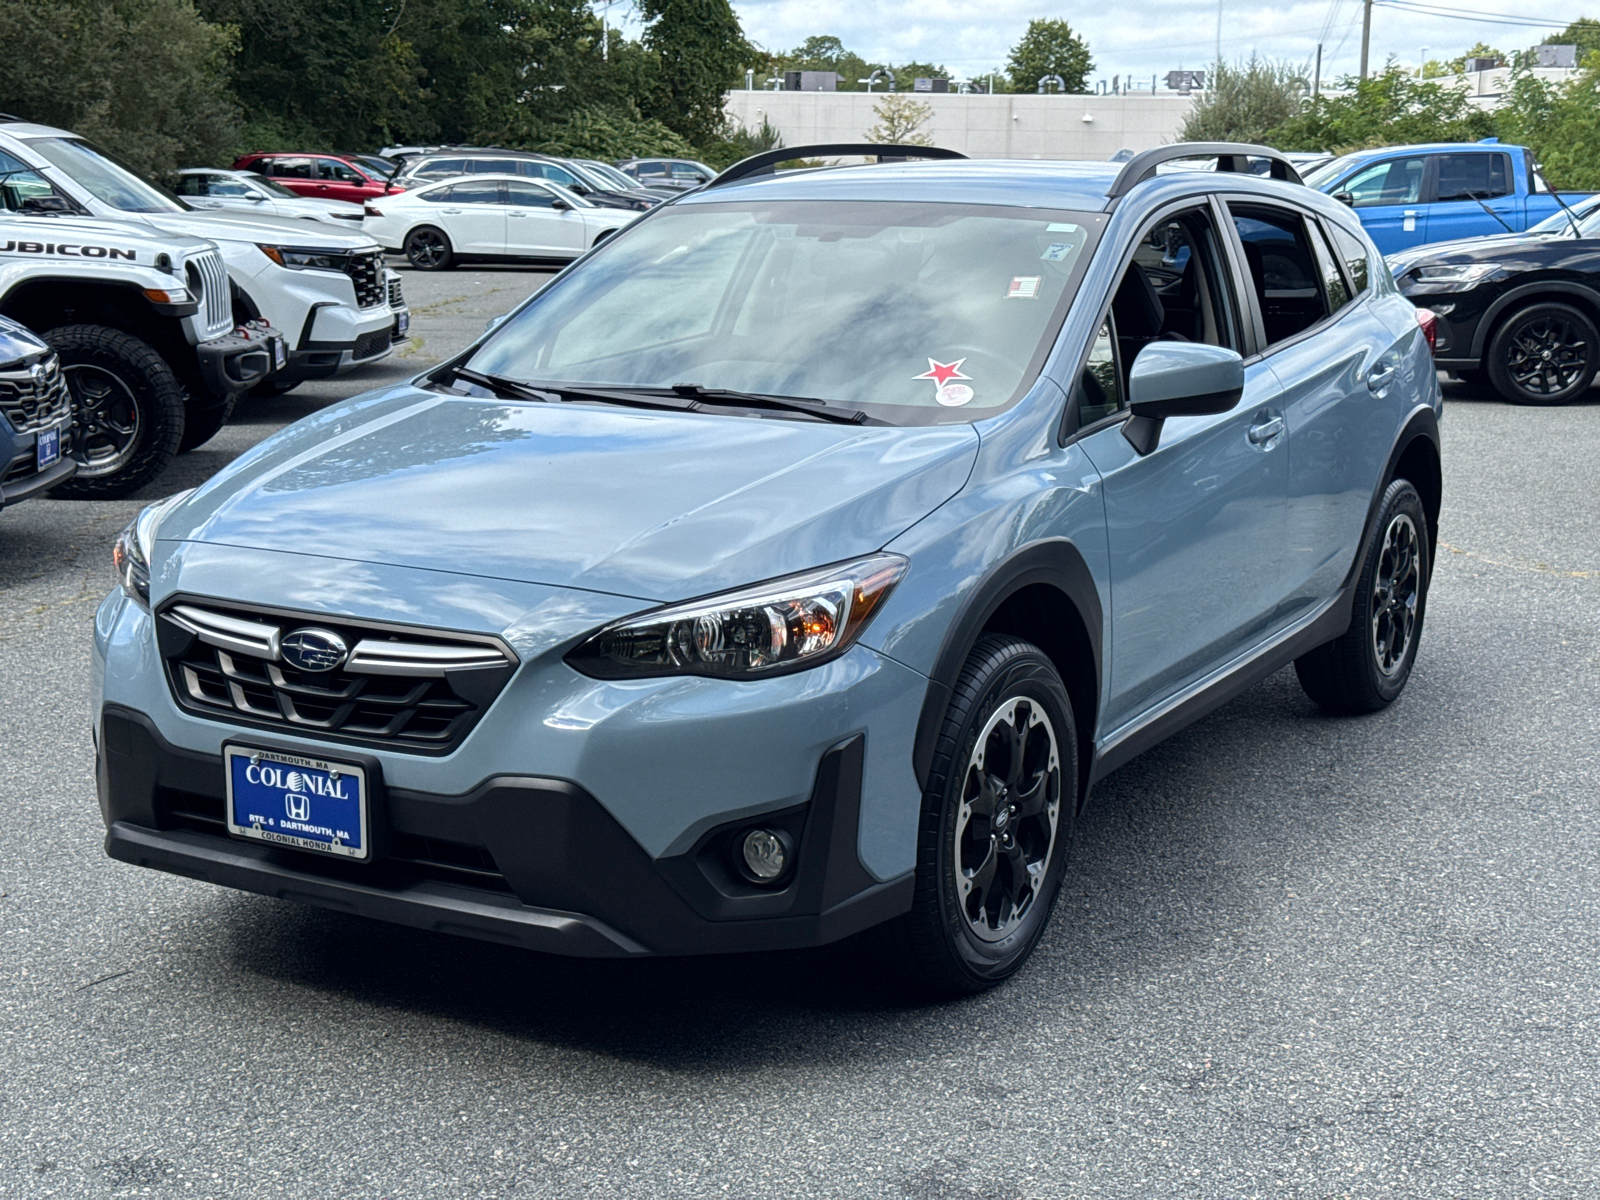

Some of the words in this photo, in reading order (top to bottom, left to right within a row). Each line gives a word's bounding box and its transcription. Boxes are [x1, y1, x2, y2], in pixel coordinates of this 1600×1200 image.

[258, 751, 314, 767] DARTMOUTH,
[316, 761, 329, 769] MA
[246, 765, 349, 800] COLONIAL
[249, 814, 267, 825] RTE.
[269, 818, 274, 826] 6
[280, 819, 335, 838] DARTMOUTH,
[336, 829, 350, 839] MA
[261, 831, 300, 846] COLONIAL
[302, 836, 332, 851] HONDA
